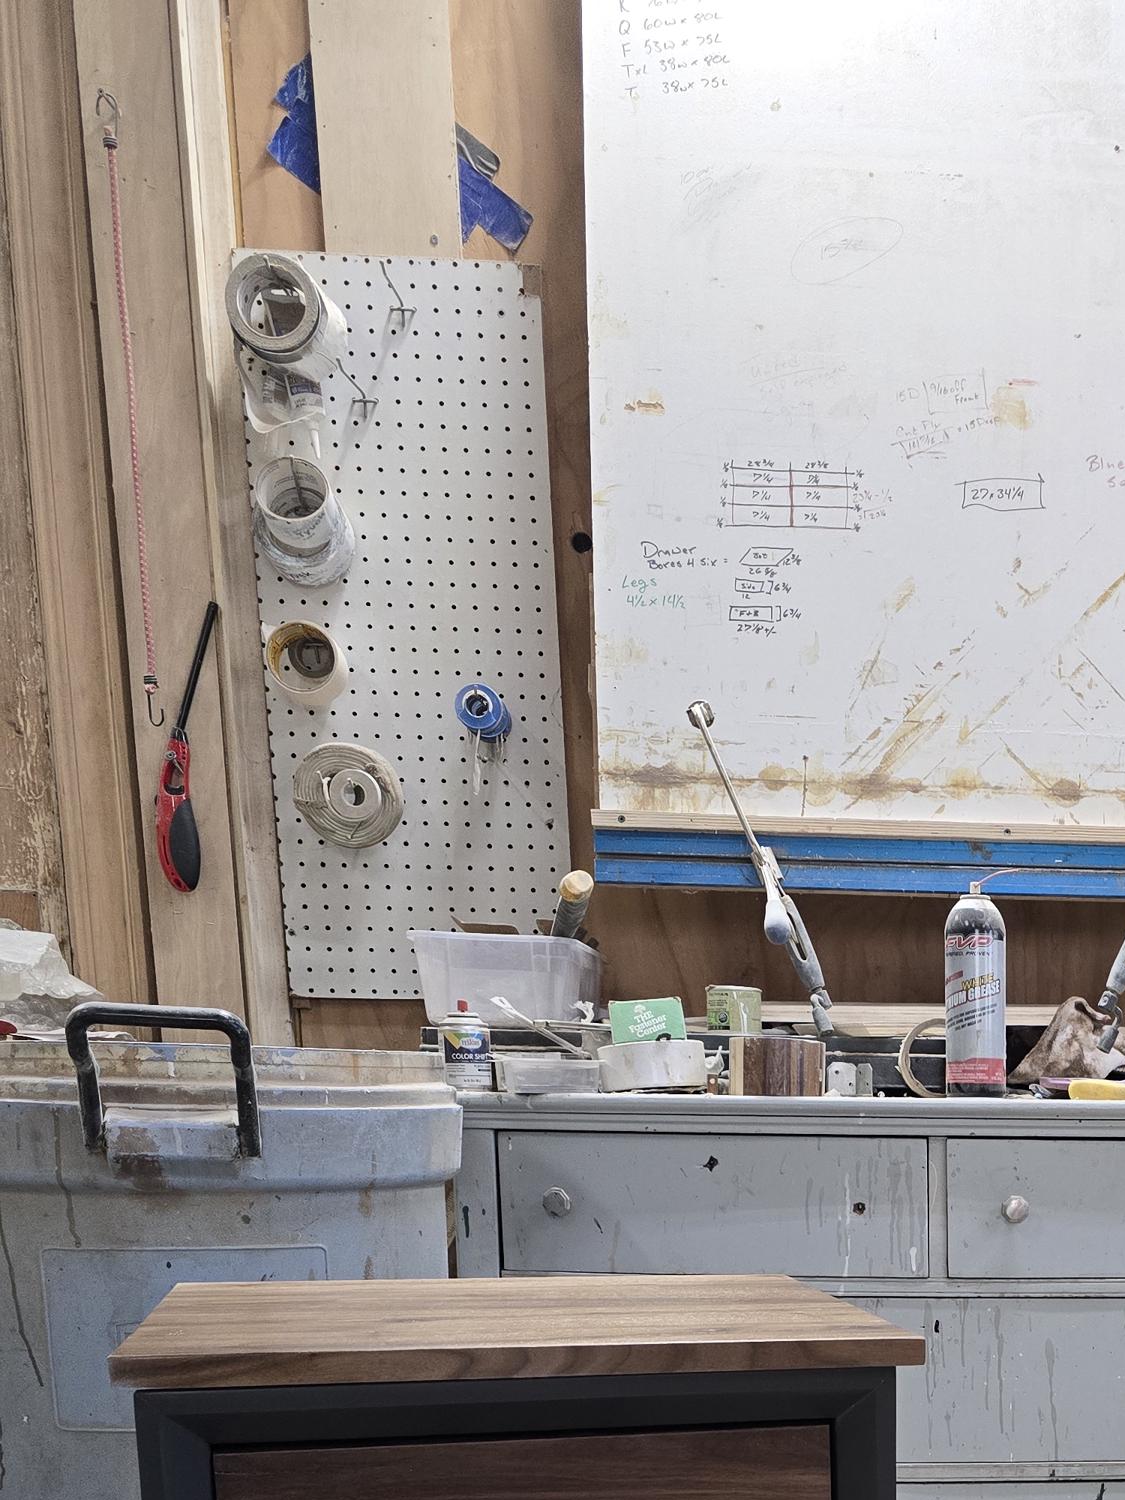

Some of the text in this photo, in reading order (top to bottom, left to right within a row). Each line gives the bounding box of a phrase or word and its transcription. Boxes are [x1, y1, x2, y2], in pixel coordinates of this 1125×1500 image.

[619, 20, 631, 35] Q
[622, 42, 631, 57] F
[624, 86, 637, 97] T
[971, 488, 989, 500] 27
[641, 541, 696, 558] Drawer
[622, 575, 657, 593] Legs
[967, 979, 1001, 1002] GREASE
[629, 1014, 667, 1033] Fastener
[634, 1010, 655, 1023] THE
[636, 1022, 667, 1038] Center
[451, 1052, 473, 1060] COLOR
